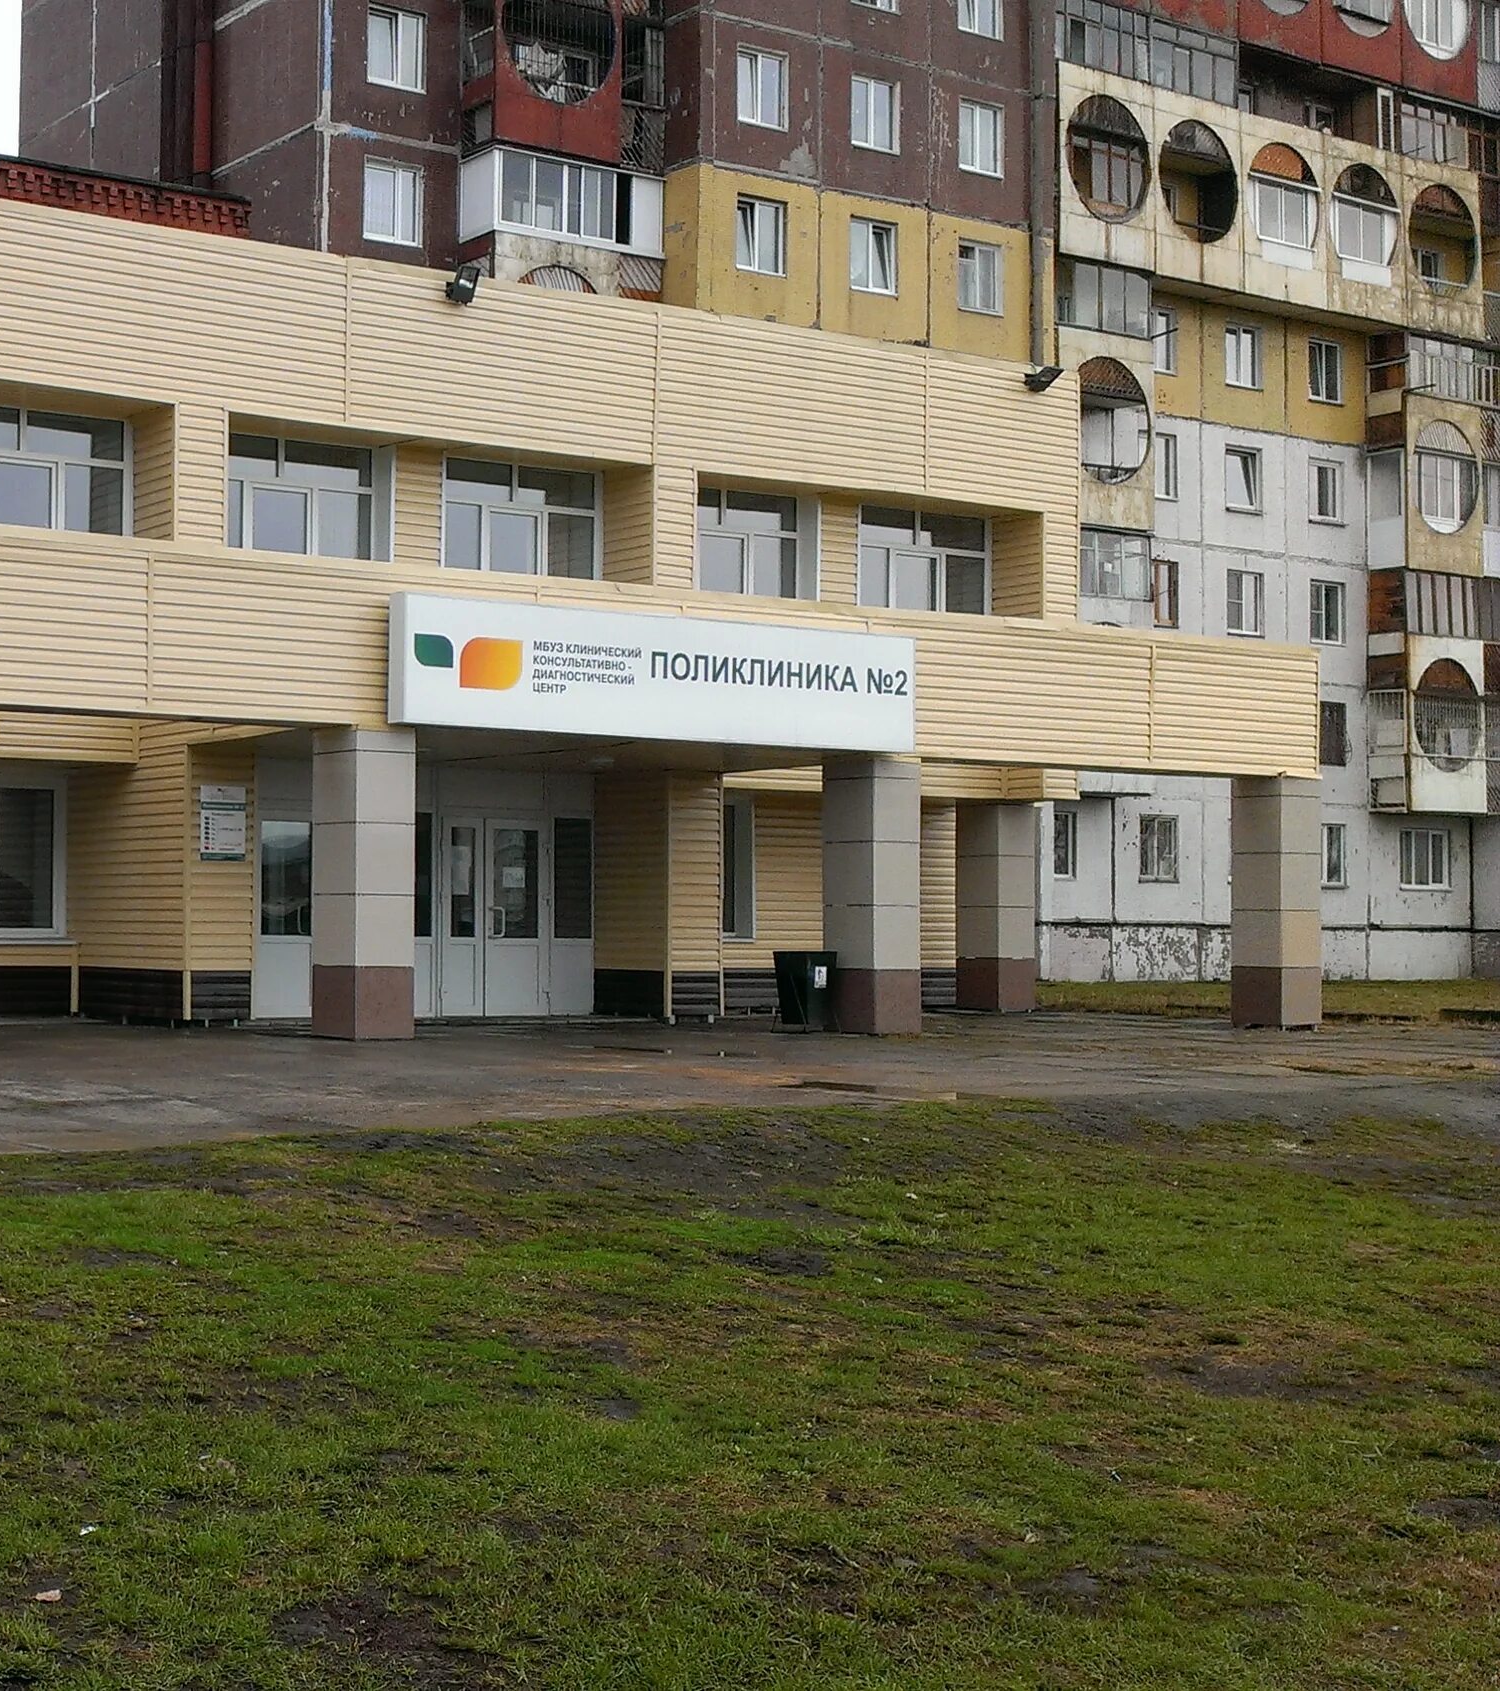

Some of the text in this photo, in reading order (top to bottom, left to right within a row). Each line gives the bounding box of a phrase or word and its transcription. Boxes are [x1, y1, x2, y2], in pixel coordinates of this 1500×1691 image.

[533, 640, 642, 659] МБУЗ КЛИНИЧЕСКИЙ
[532, 668, 635, 685] ДИАГНОСТИЧЕСКИЙ
[651, 651, 908, 696] ПОЛИКЛИНИКА №2
[533, 682, 567, 694] ЦЕНТР
